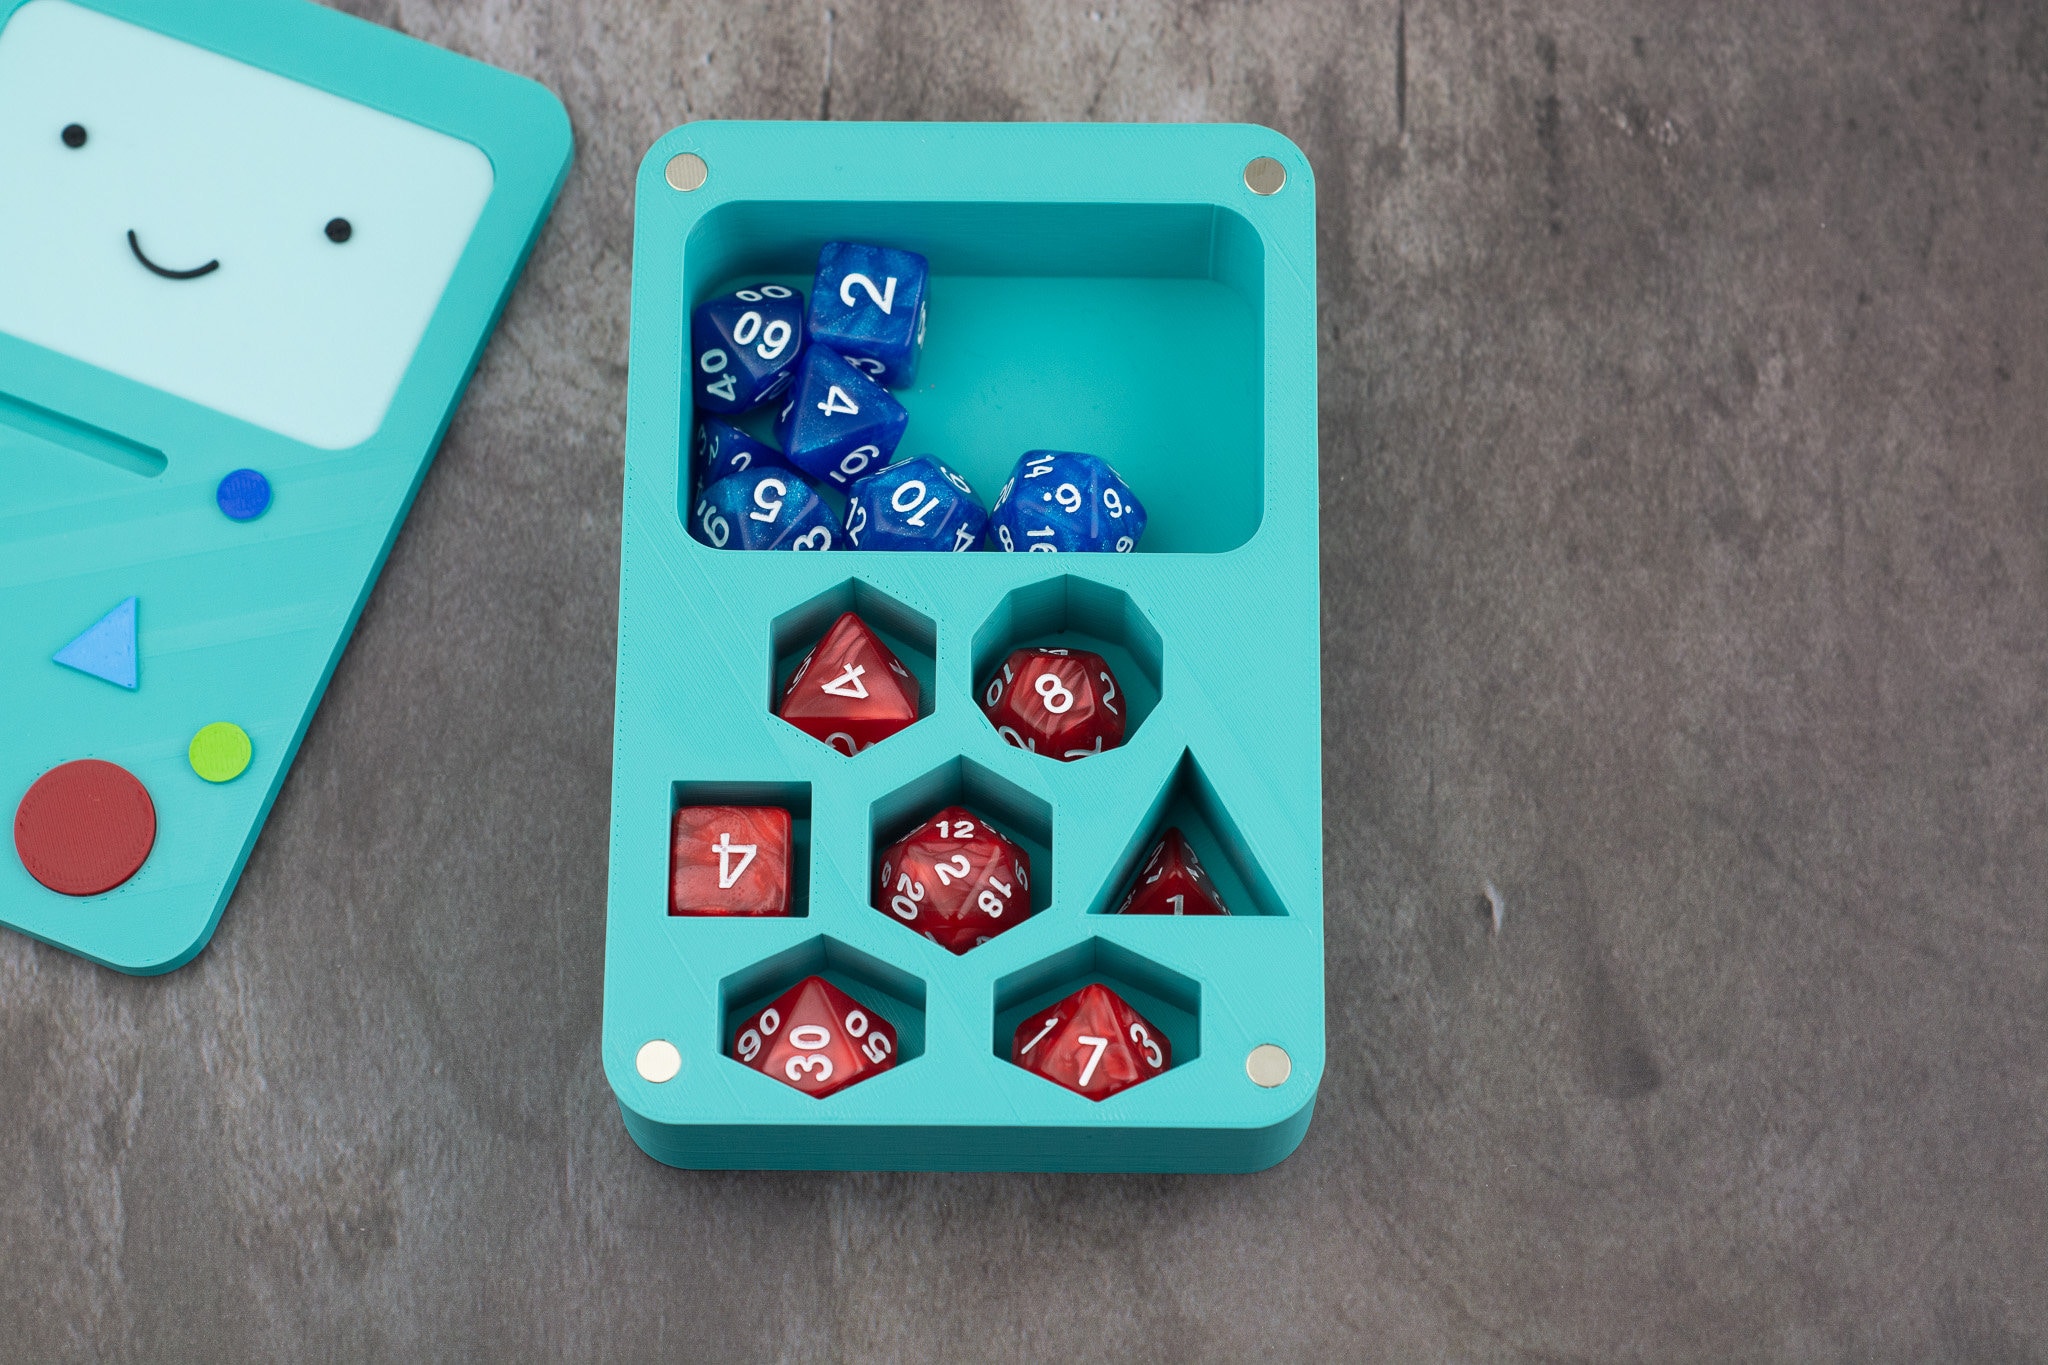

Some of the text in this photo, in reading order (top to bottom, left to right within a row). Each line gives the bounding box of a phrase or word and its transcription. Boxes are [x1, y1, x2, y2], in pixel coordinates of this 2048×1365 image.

[839, 272, 898, 316] 2
[700, 348, 737, 402] 40
[817, 385, 860, 417] 4
[749, 478, 787, 524] 5
[845, 496, 867, 547] 12
[891, 479, 940, 528] 10
[820, 662, 870, 699] 4
[986, 663, 1015, 708] 10
[1034, 673, 1074, 714] 8
[1099, 671, 1118, 715] 2
[935, 820, 975, 839] 12
[711, 832, 758, 889] 4
[934, 854, 971, 886] 2
[891, 872, 925, 921] 20
[977, 875, 1012, 919] 18
[1165, 894, 1185, 916] 1
[784, 1024, 834, 1082] 30
[845, 1009, 892, 1065] 50
[1020, 1017, 1059, 1056] 1
[1129, 1022, 1163, 1069] 3
[1077, 1035, 1109, 1088] 7
